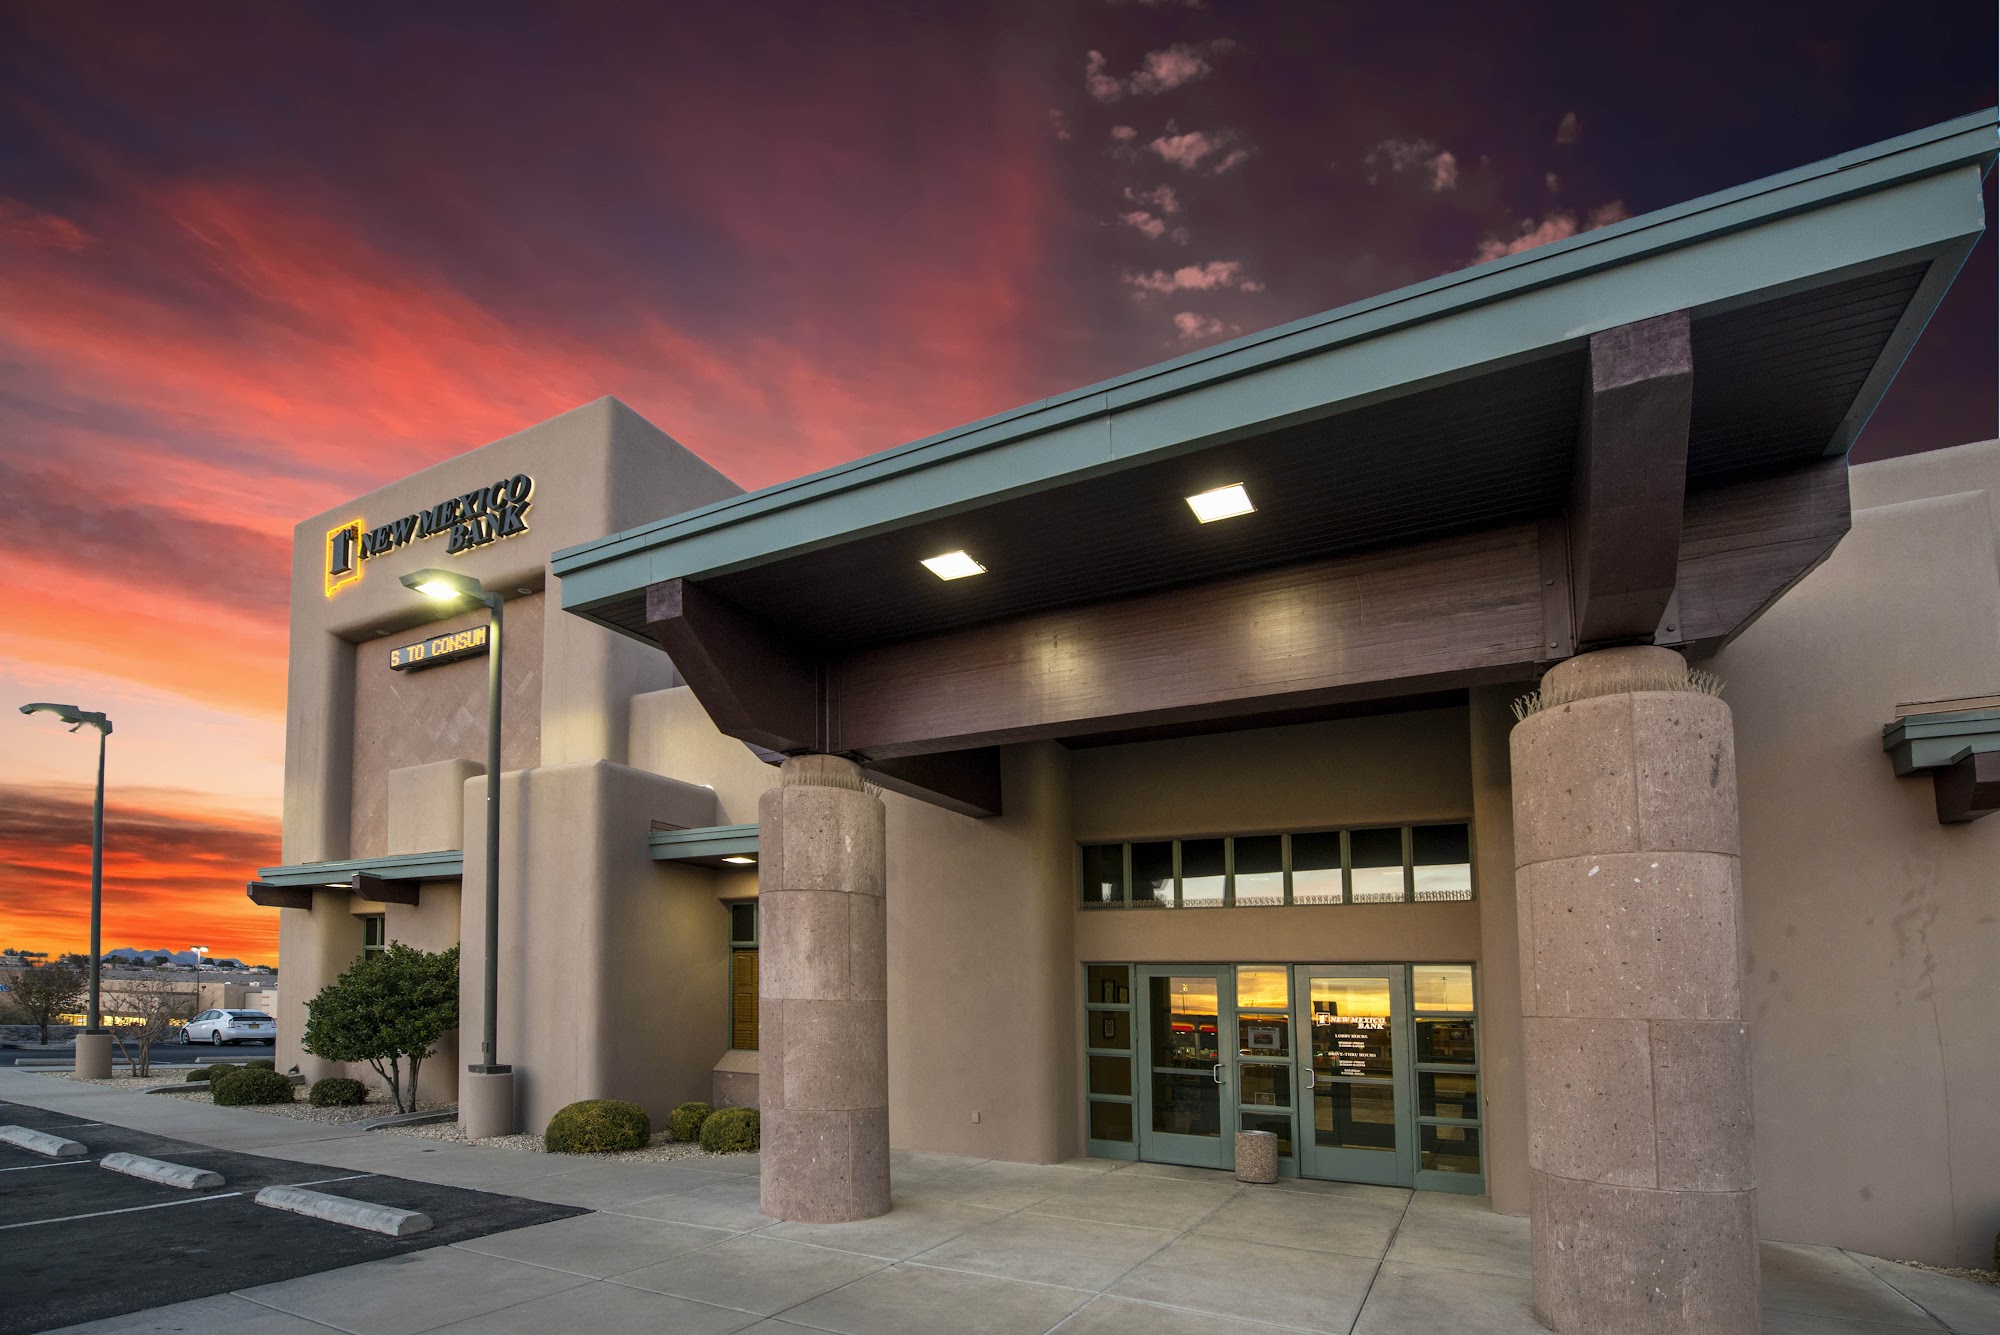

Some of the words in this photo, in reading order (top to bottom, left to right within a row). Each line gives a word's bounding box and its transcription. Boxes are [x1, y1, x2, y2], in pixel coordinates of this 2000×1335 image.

[358, 514, 419, 559] NEW
[416, 473, 533, 539] MEXICO
[446, 501, 531, 555] BANK
[406, 644, 425, 662] TO
